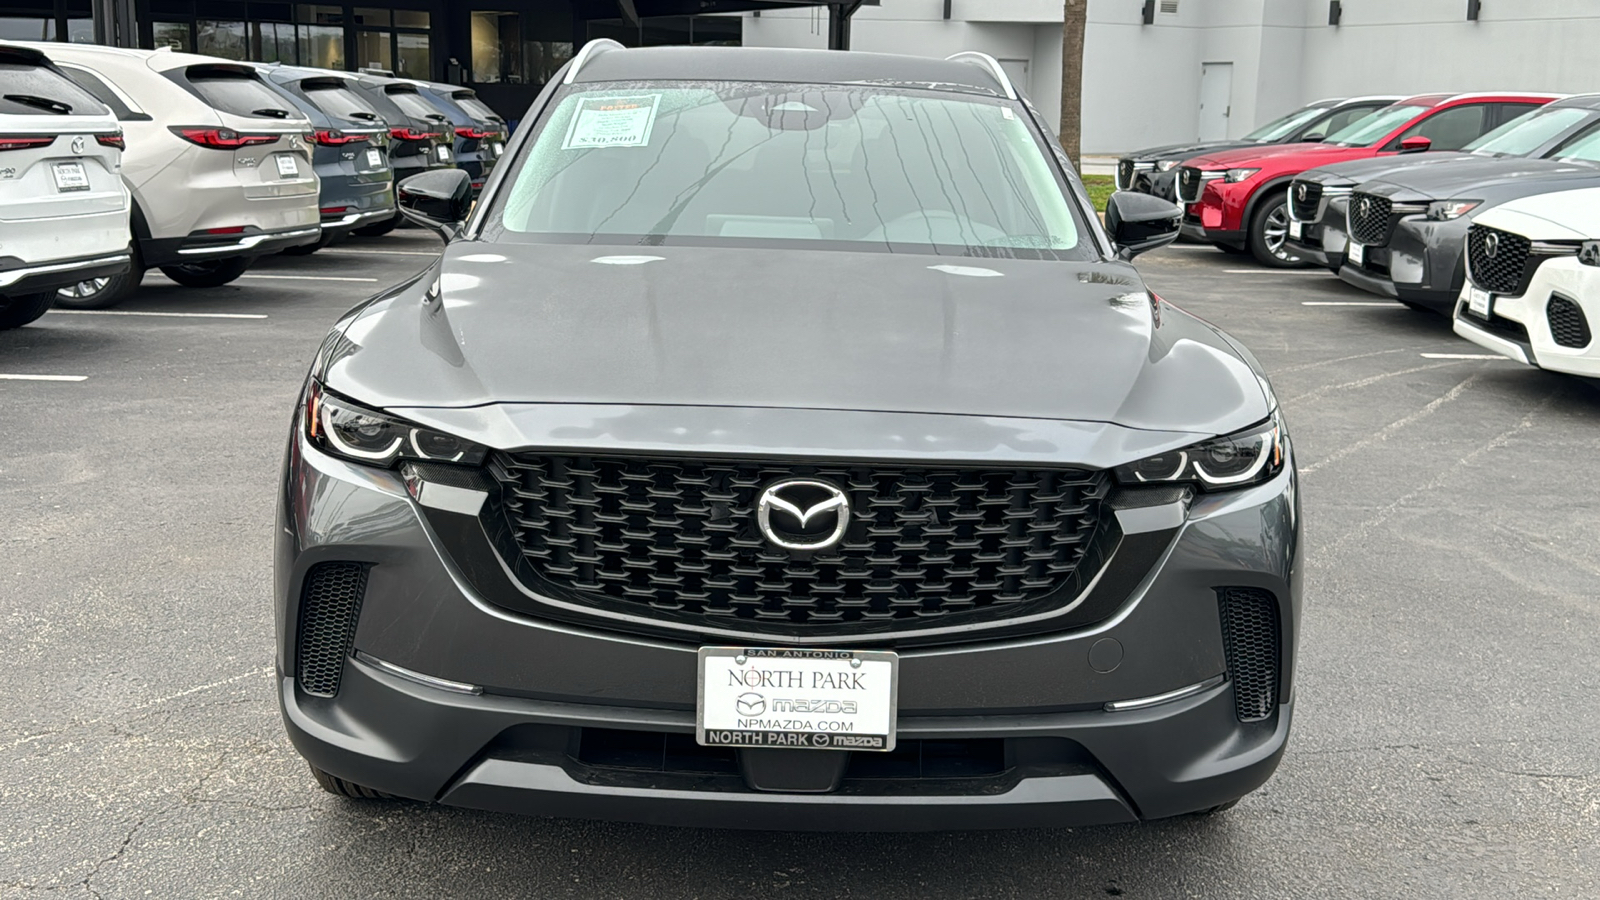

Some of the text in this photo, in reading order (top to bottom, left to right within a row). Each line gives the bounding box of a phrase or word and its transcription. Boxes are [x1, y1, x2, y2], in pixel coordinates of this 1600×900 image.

[747, 649, 850, 659] SAN ANTONIO
[728, 669, 867, 690] NORTH PARK
[772, 698, 858, 714] mazda
[737, 718, 853, 731] NPMAZDA.COM
[709, 731, 882, 747] NORTH PARK mazda
